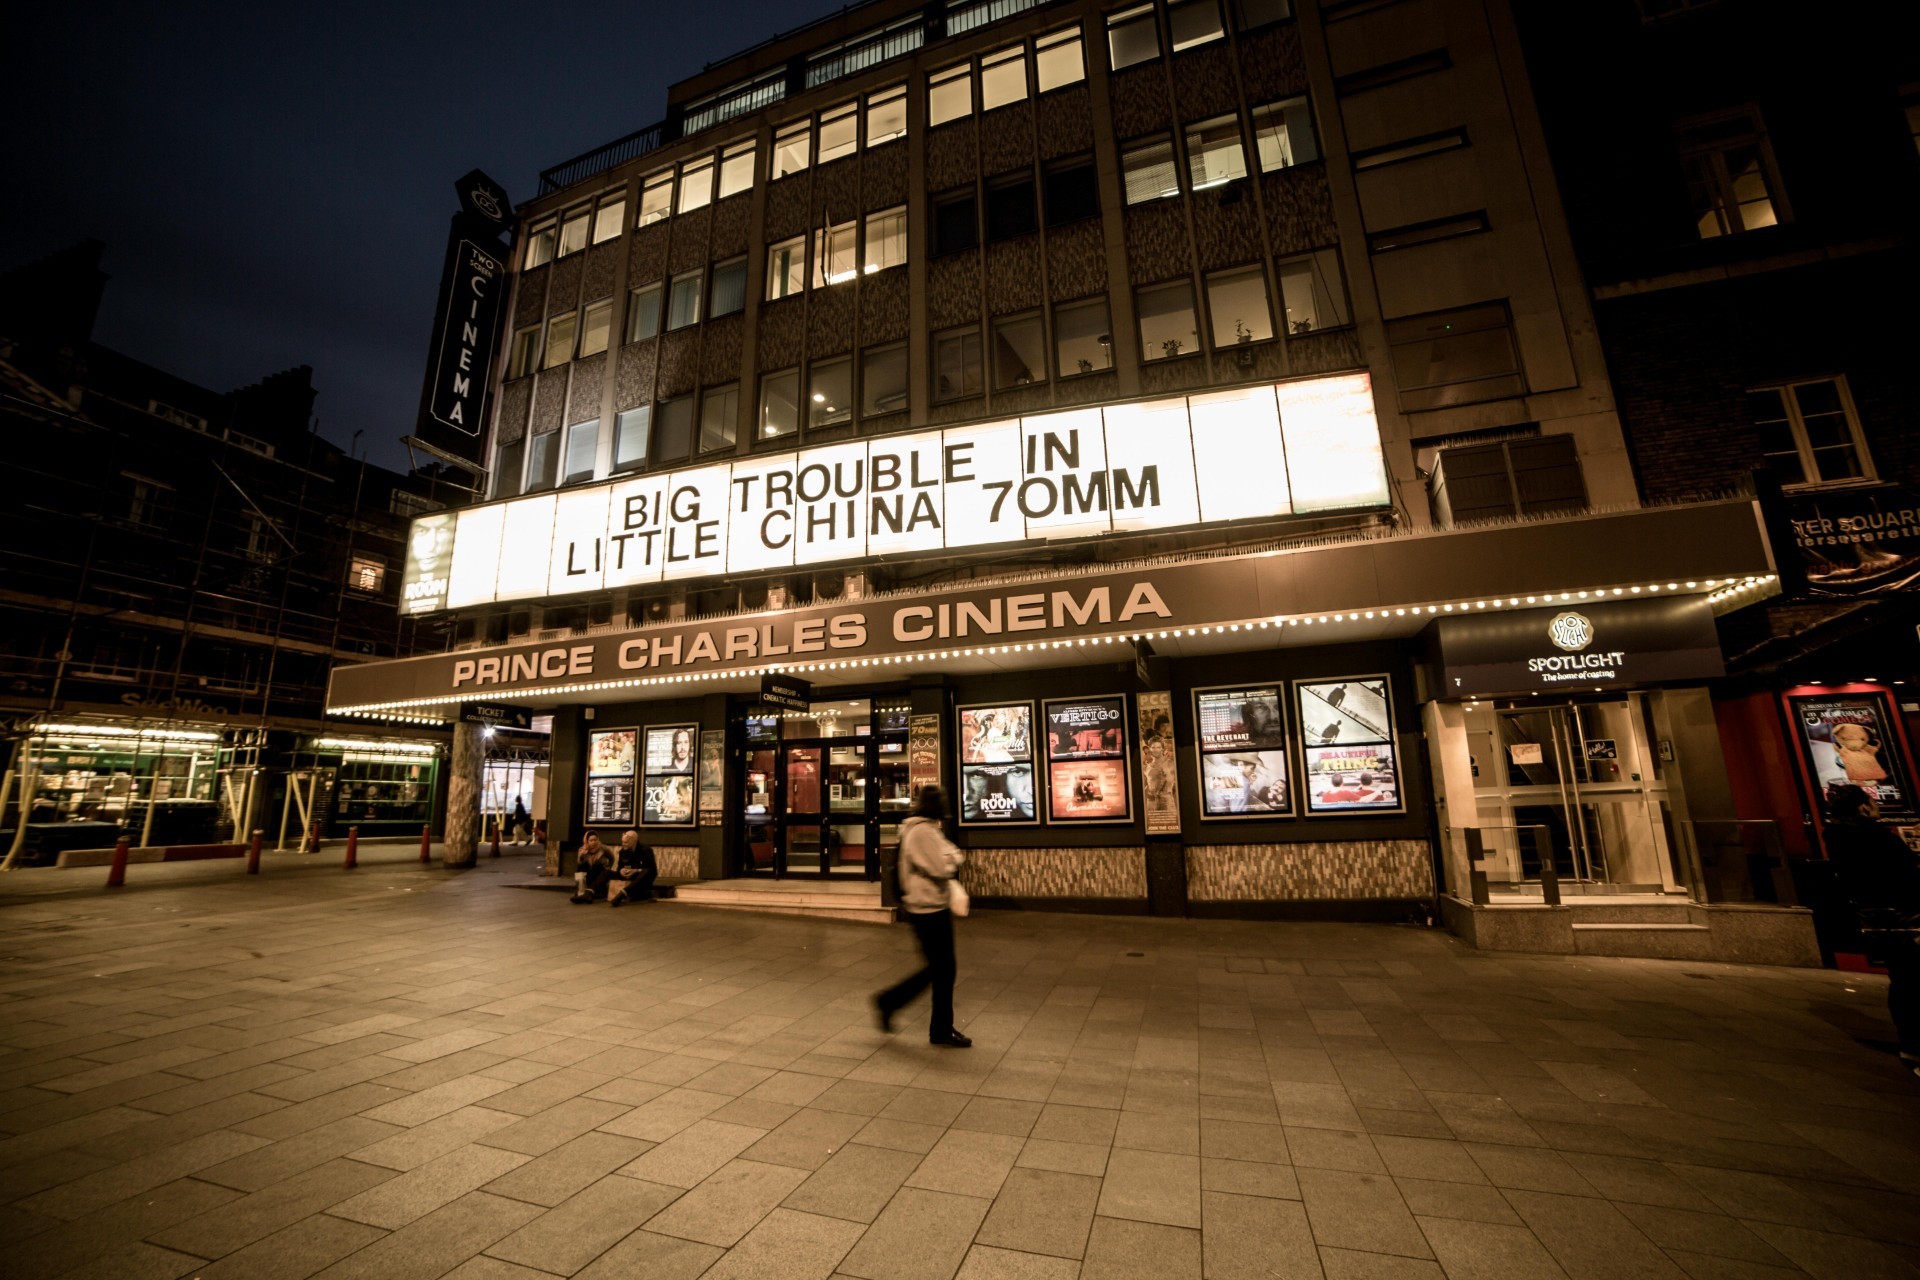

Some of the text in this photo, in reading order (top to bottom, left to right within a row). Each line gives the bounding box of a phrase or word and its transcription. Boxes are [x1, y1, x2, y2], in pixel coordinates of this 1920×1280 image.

[472, 248, 495, 270] TWO
[469, 259, 492, 279] SCREEN
[449, 276, 487, 424] CINEMA
[623, 428, 1080, 531] BIG TROUBLE IN
[566, 519, 720, 577] LITTLE
[760, 489, 942, 551] CHINA
[452, 581, 1173, 688] PRINCE CHARLES CINEMA
[1528, 652, 1625, 672] SPOTLIGHT
[1542, 670, 1615, 682] The home of casting
[763, 693, 808, 708] CINEMATIC HAPPINESS
[477, 706, 505, 718] TICKET
[1049, 709, 1120, 724] VERTIGO
[1203, 733, 1250, 743] THE REVENANT
[1319, 749, 1378, 760] BEAUTIFUL
[1320, 756, 1379, 771] THING
[980, 798, 1018, 810] ROOM
